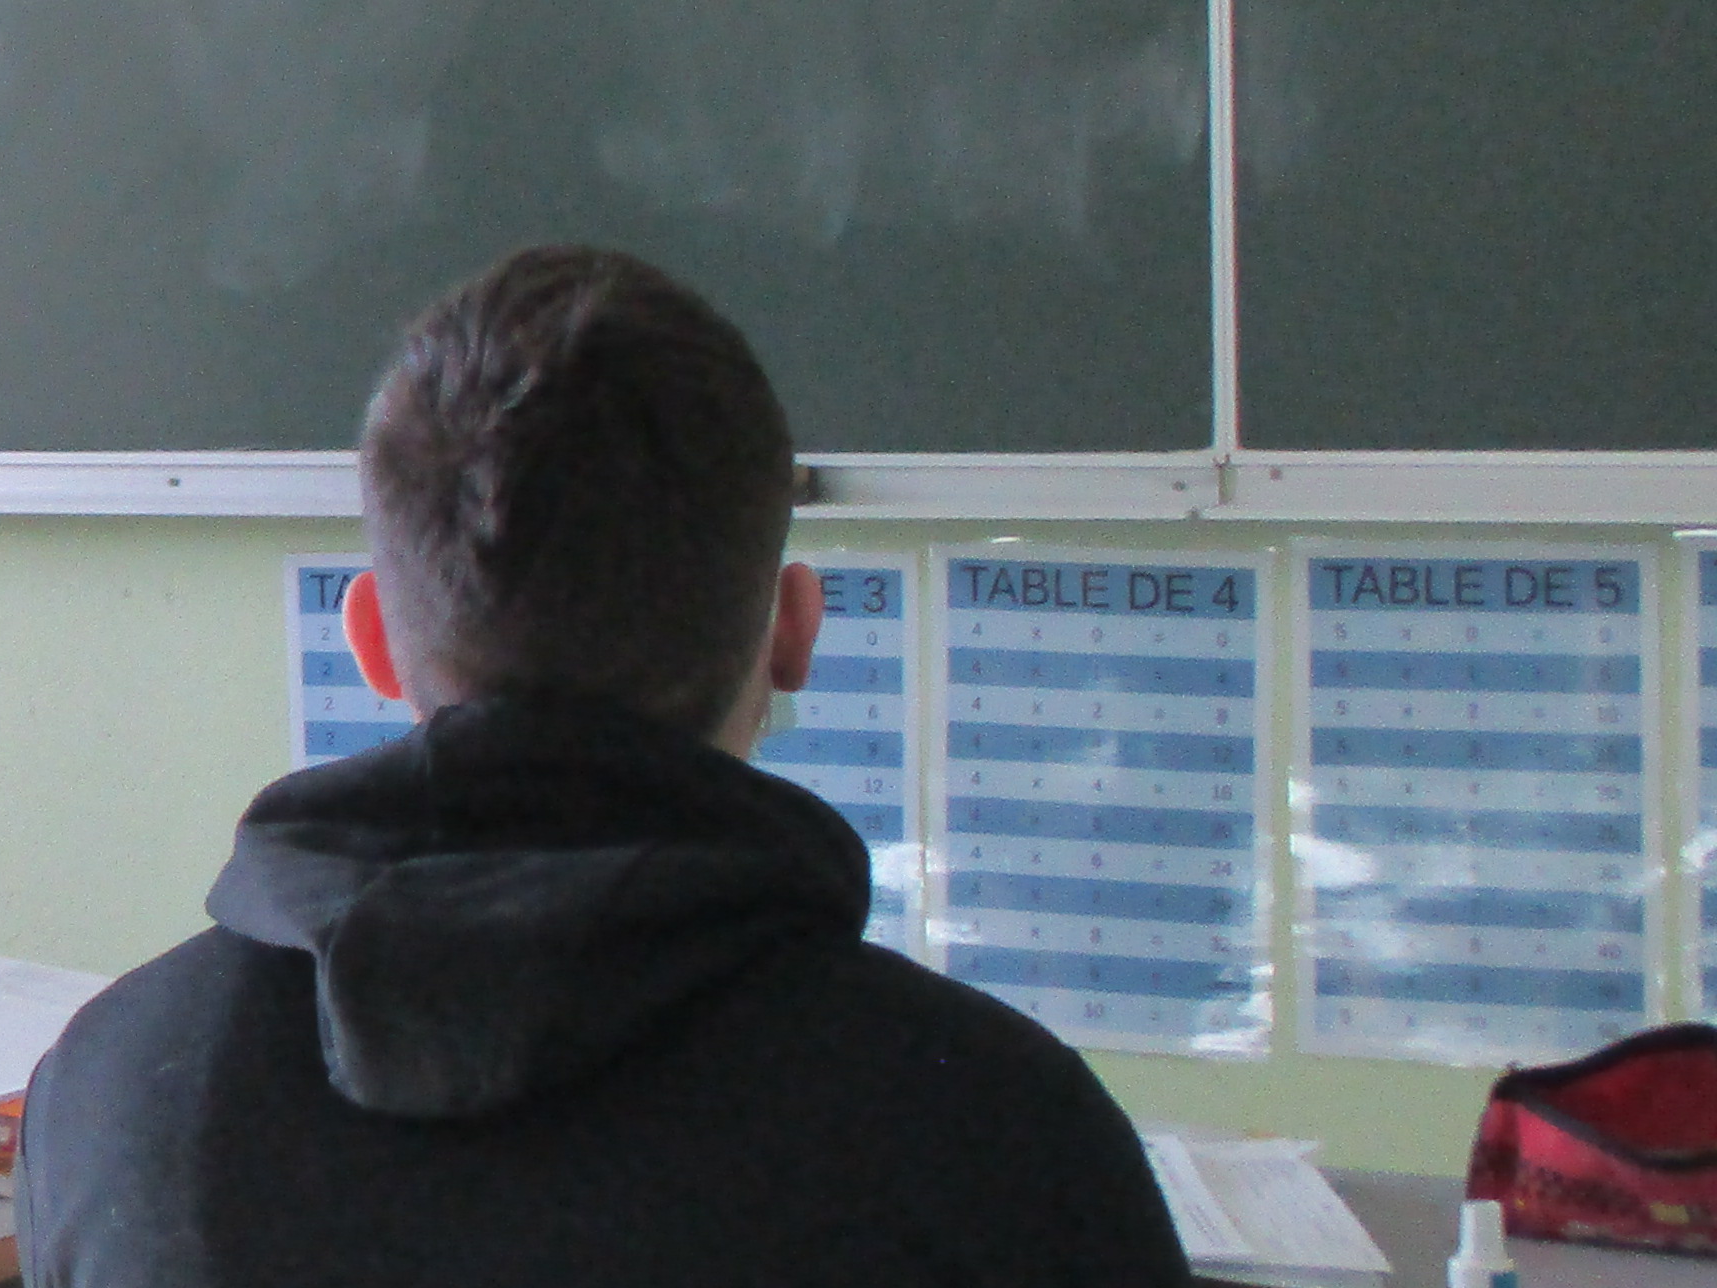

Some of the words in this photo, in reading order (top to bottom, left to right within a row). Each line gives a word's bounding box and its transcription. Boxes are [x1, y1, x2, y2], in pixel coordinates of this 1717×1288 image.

[863, 576, 887, 613] 3
[960, 565, 1111, 610] TABLE
[1127, 570, 1196, 613] DE
[1212, 573, 1240, 612] 4
[1322, 564, 1485, 607] TABLE
[1504, 566, 1575, 608] DE
[1594, 566, 1623, 608] 5
[320, 627, 330, 641] 2
[324, 697, 336, 711] 2
